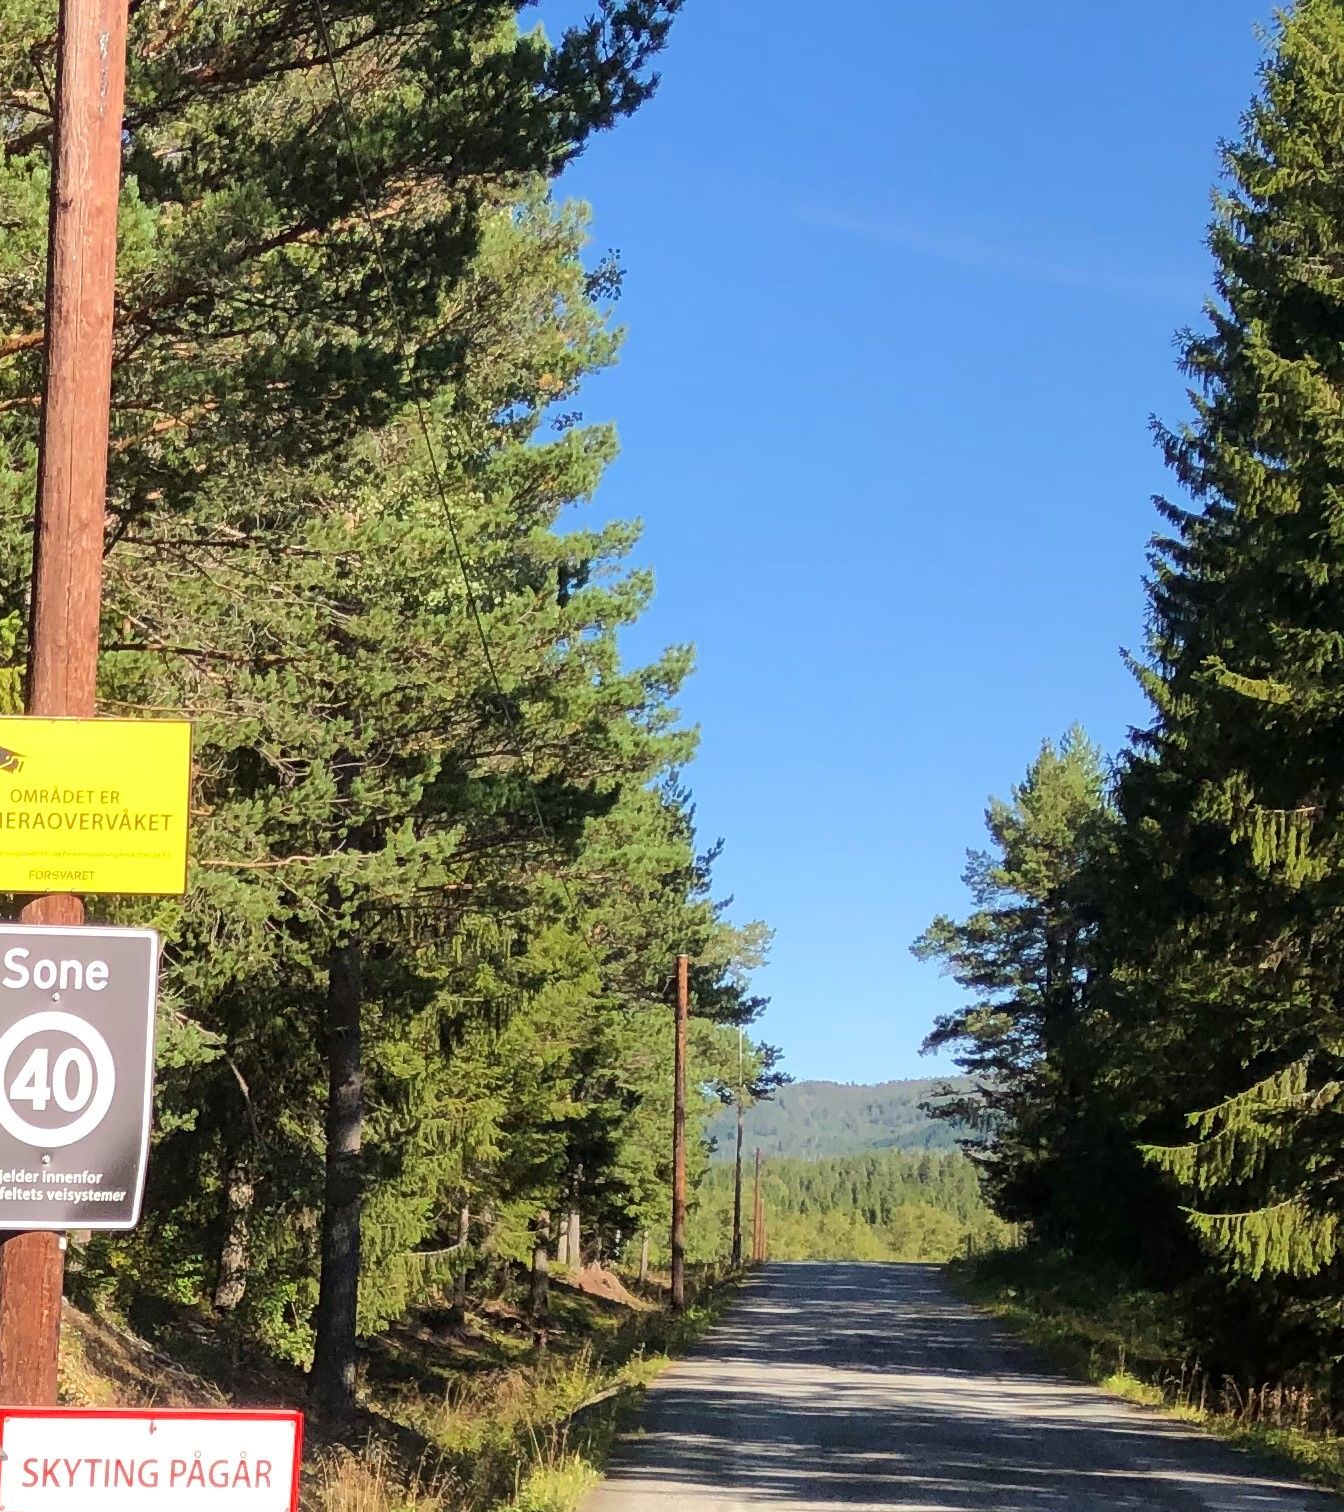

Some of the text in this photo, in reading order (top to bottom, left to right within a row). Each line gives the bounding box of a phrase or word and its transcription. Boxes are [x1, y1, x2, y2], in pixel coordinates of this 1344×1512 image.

[10, 786, 120, 804] OMRÅDET ER
[28, 870, 95, 881] FORSVARET
[2, 947, 110, 992] Sone
[9, 1047, 94, 1113] 40
[42, 1170, 104, 1185] innenfor
[46, 1188, 127, 1204] veisystemer
[21, 1450, 273, 1489] SKYTING PÅGÅR
